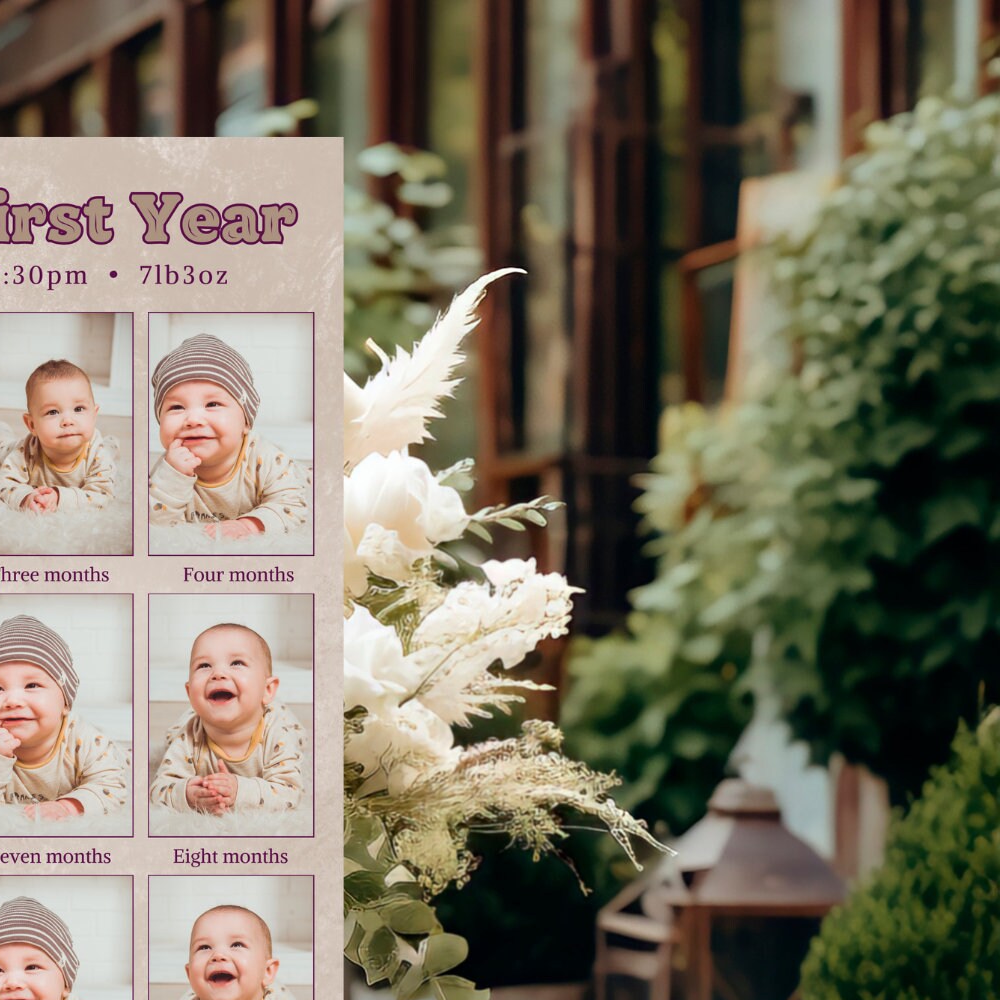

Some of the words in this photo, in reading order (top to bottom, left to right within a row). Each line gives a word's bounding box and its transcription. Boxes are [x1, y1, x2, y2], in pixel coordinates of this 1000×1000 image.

[129, 191, 299, 245] Year
[139, 263, 229, 285] 7lb3oz
[44, 566, 110, 583] months
[183, 567, 225, 583] Four
[229, 566, 295, 583] months
[46, 847, 112, 864] months
[173, 847, 219, 868] Eight
[222, 847, 289, 864] months
